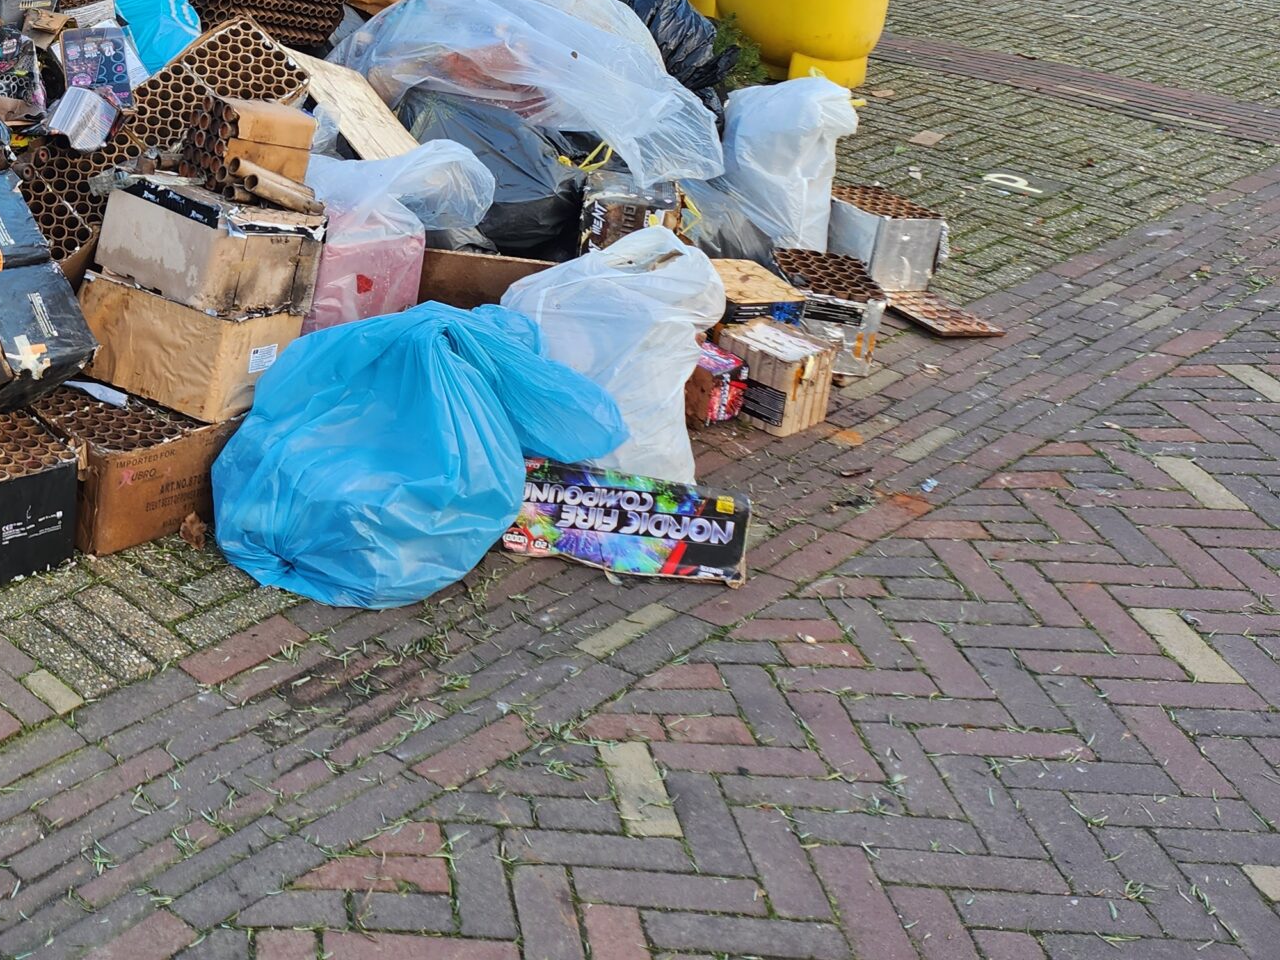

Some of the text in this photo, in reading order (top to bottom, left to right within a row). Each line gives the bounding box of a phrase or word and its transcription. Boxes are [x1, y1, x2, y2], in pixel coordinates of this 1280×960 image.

[116, 454, 159, 469] IMPORTED
[556, 504, 735, 545] NORDIC FIRE
